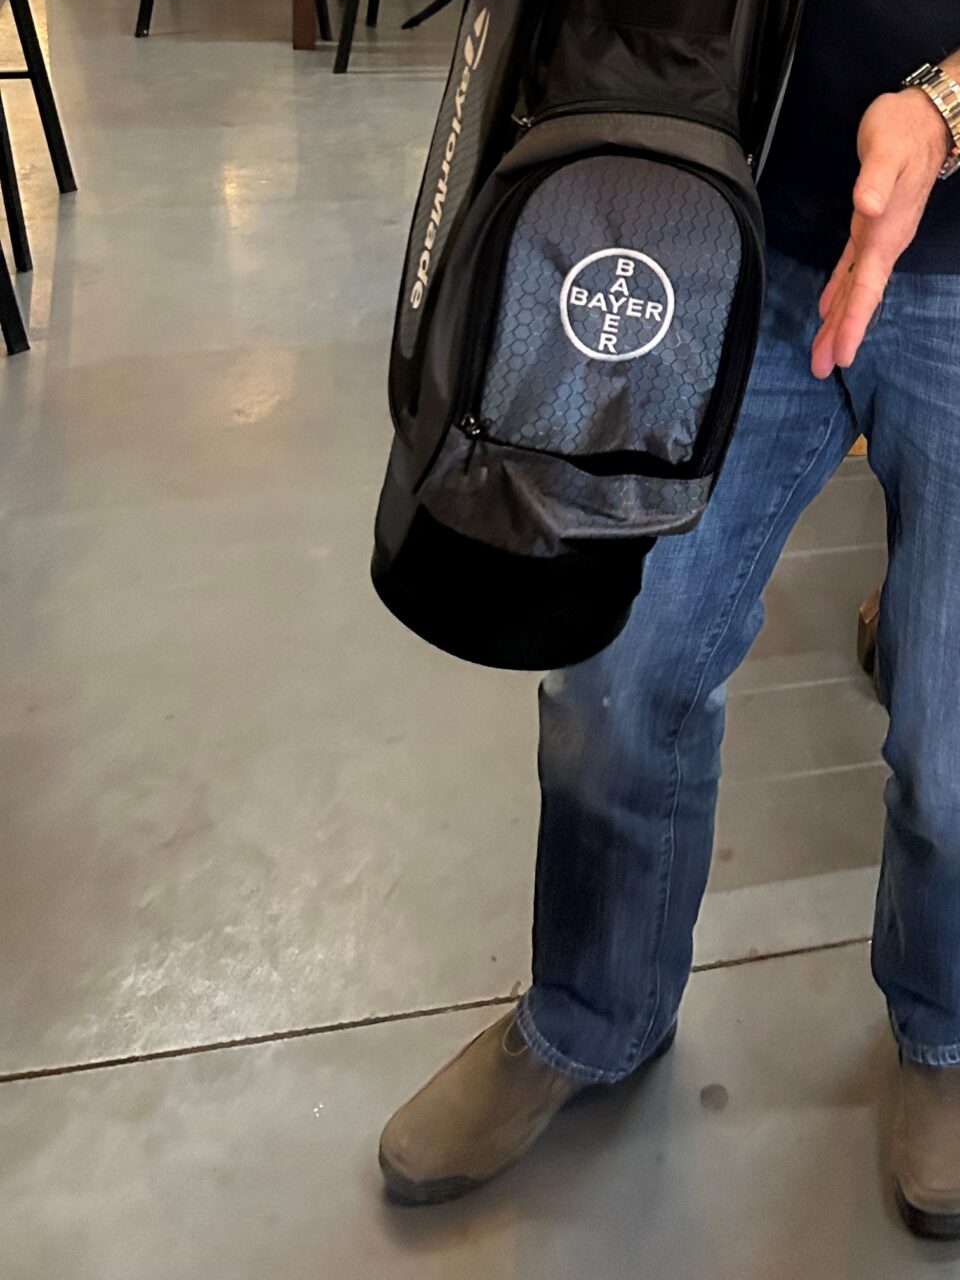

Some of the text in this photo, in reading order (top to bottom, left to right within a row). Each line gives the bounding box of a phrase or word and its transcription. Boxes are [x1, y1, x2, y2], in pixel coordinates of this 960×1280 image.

[410, 7, 490, 309] TaylorMade
[570, 286, 663, 322] BAYER
[598, 258, 635, 354] BAYER
